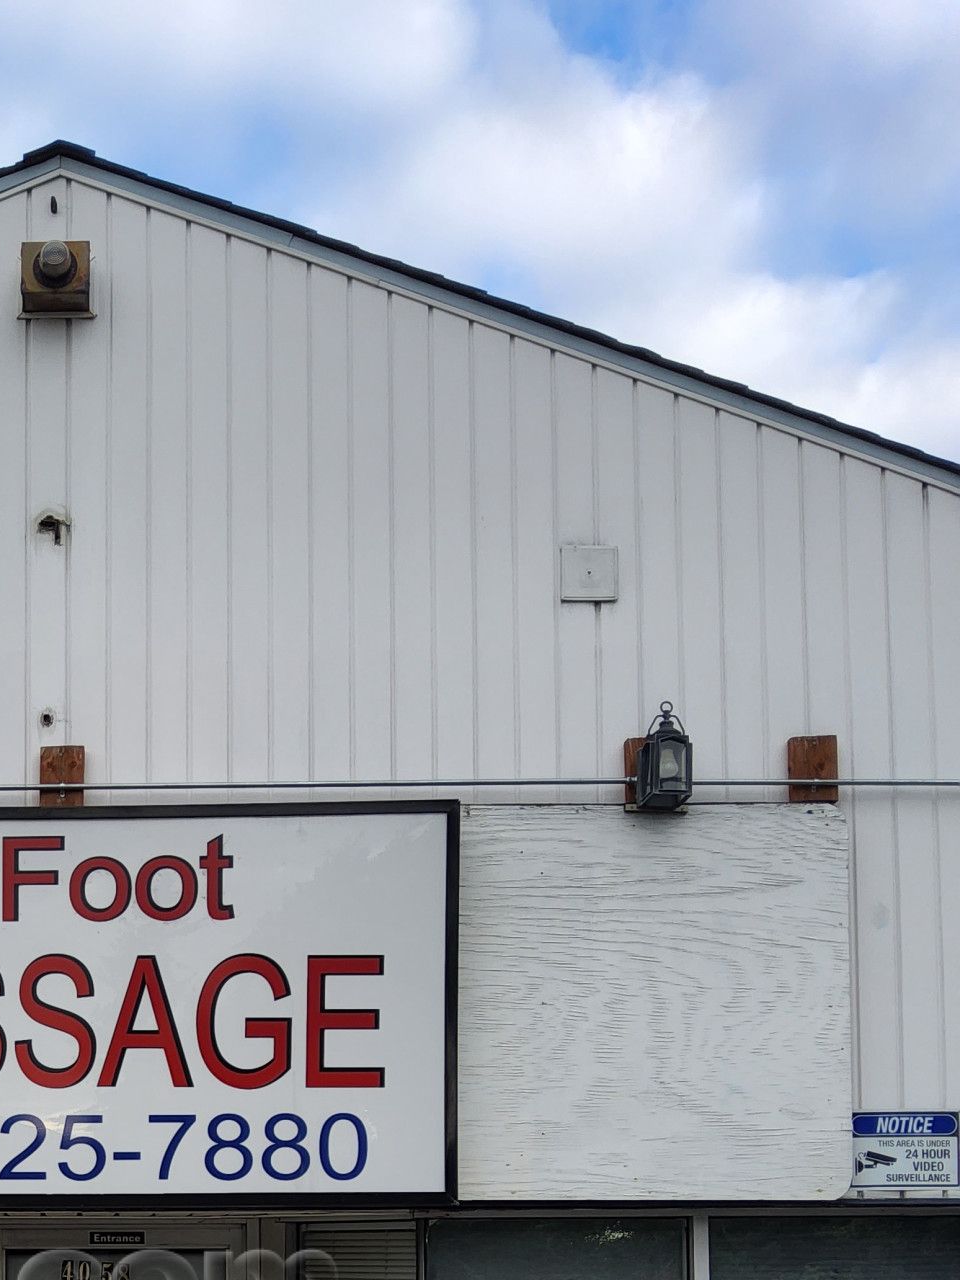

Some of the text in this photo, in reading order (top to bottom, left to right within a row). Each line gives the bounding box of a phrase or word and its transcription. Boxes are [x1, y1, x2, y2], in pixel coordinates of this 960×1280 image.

[1, 832, 236, 923] Foot
[876, 1116, 934, 1134] NOTICE
[926, 1139, 951, 1147] UNDER
[905, 1149, 951, 1159] 24 HOUR
[912, 1161, 944, 1171] VIDEO
[886, 1173, 951, 1182] SURVEILLANCE
[93, 1233, 141, 1242] Entrance
